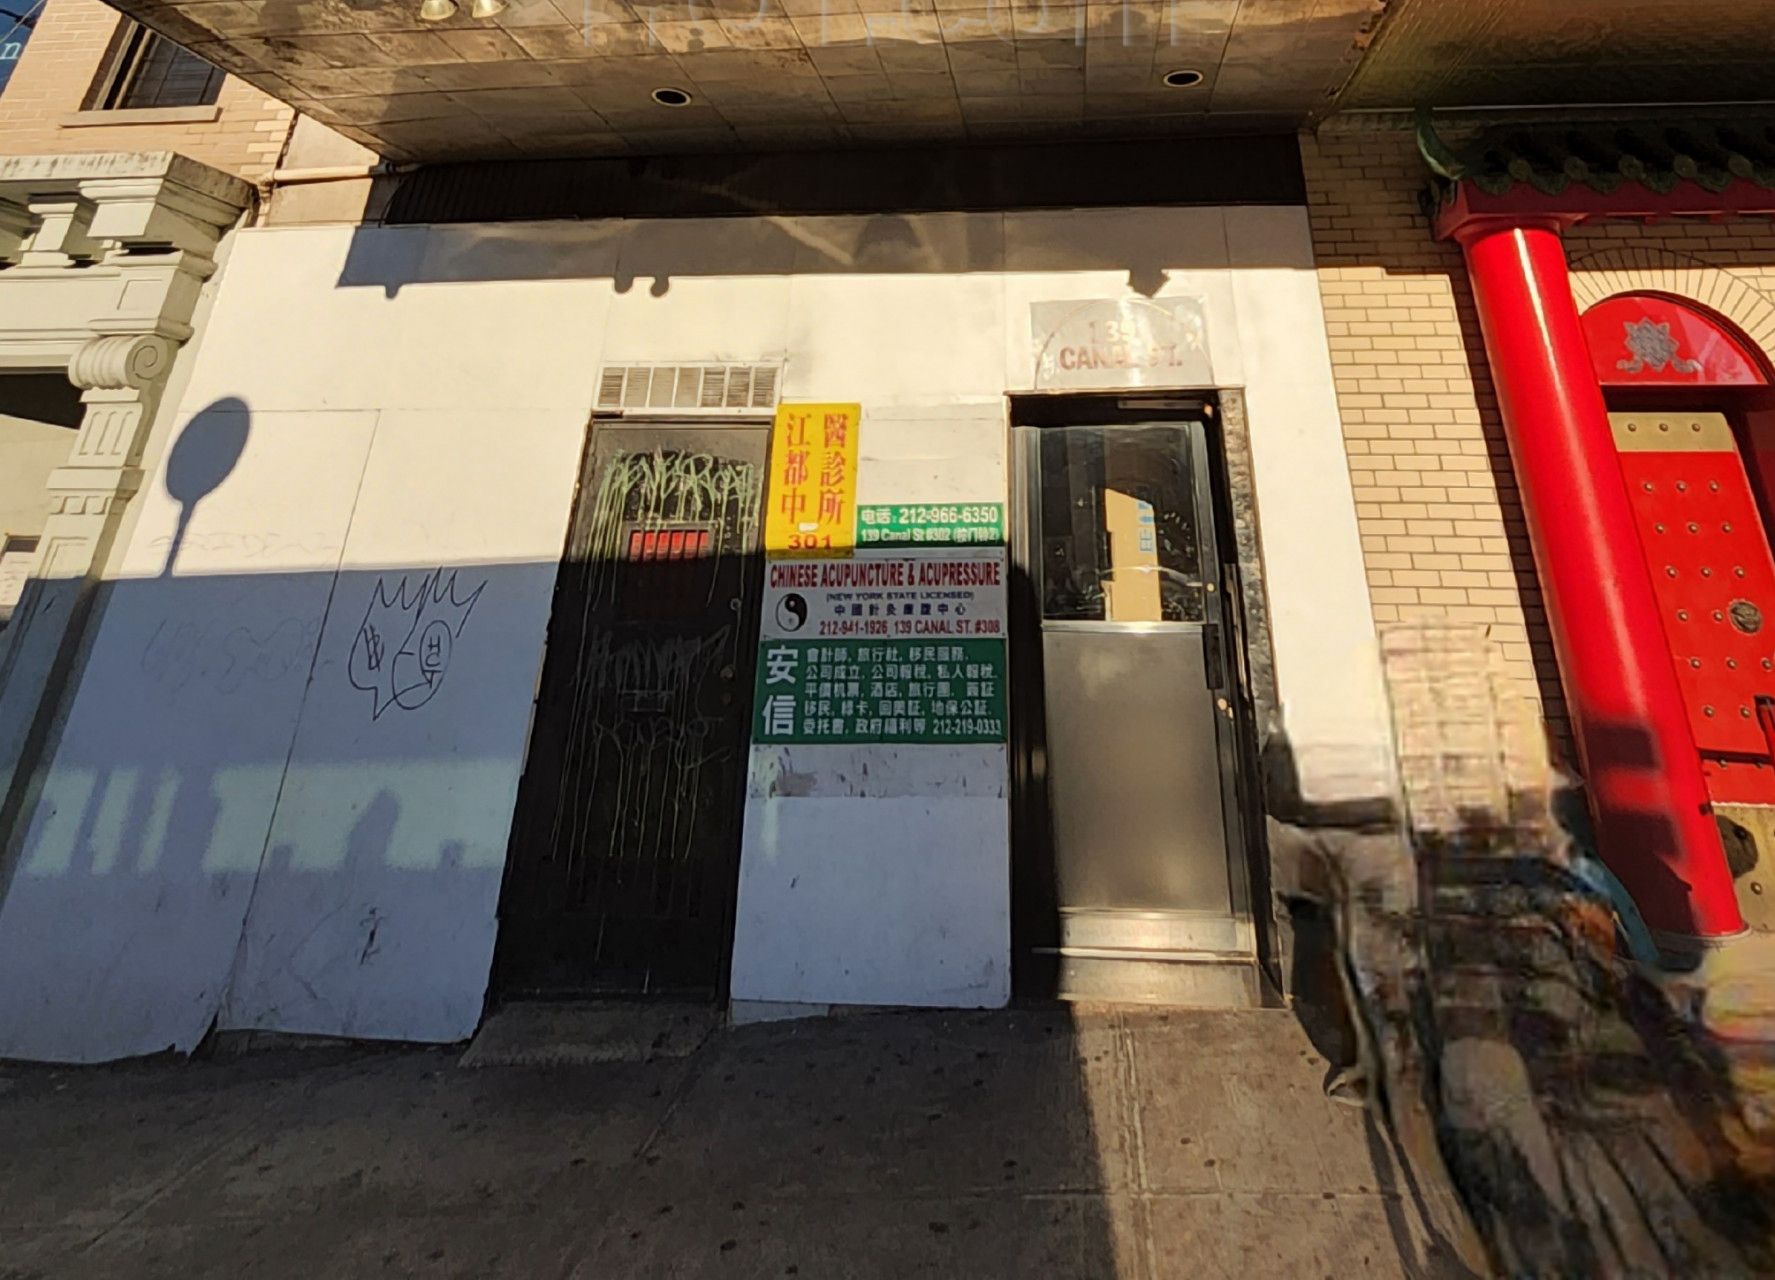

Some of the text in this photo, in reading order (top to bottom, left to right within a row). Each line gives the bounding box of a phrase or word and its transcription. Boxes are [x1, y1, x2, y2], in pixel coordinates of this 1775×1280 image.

[899, 506, 999, 524] 212-966-6350
[788, 533, 832, 551] 301
[770, 563, 818, 588] CHINESE
[820, 562, 904, 588] ACUPUNCTURE
[918, 561, 1001, 586] ACUPRESSURE
[855, 592, 883, 601] YORK
[894, 620, 911, 634] 139
[915, 619, 952, 634] CANAL
[762, 645, 799, 736] 安信
